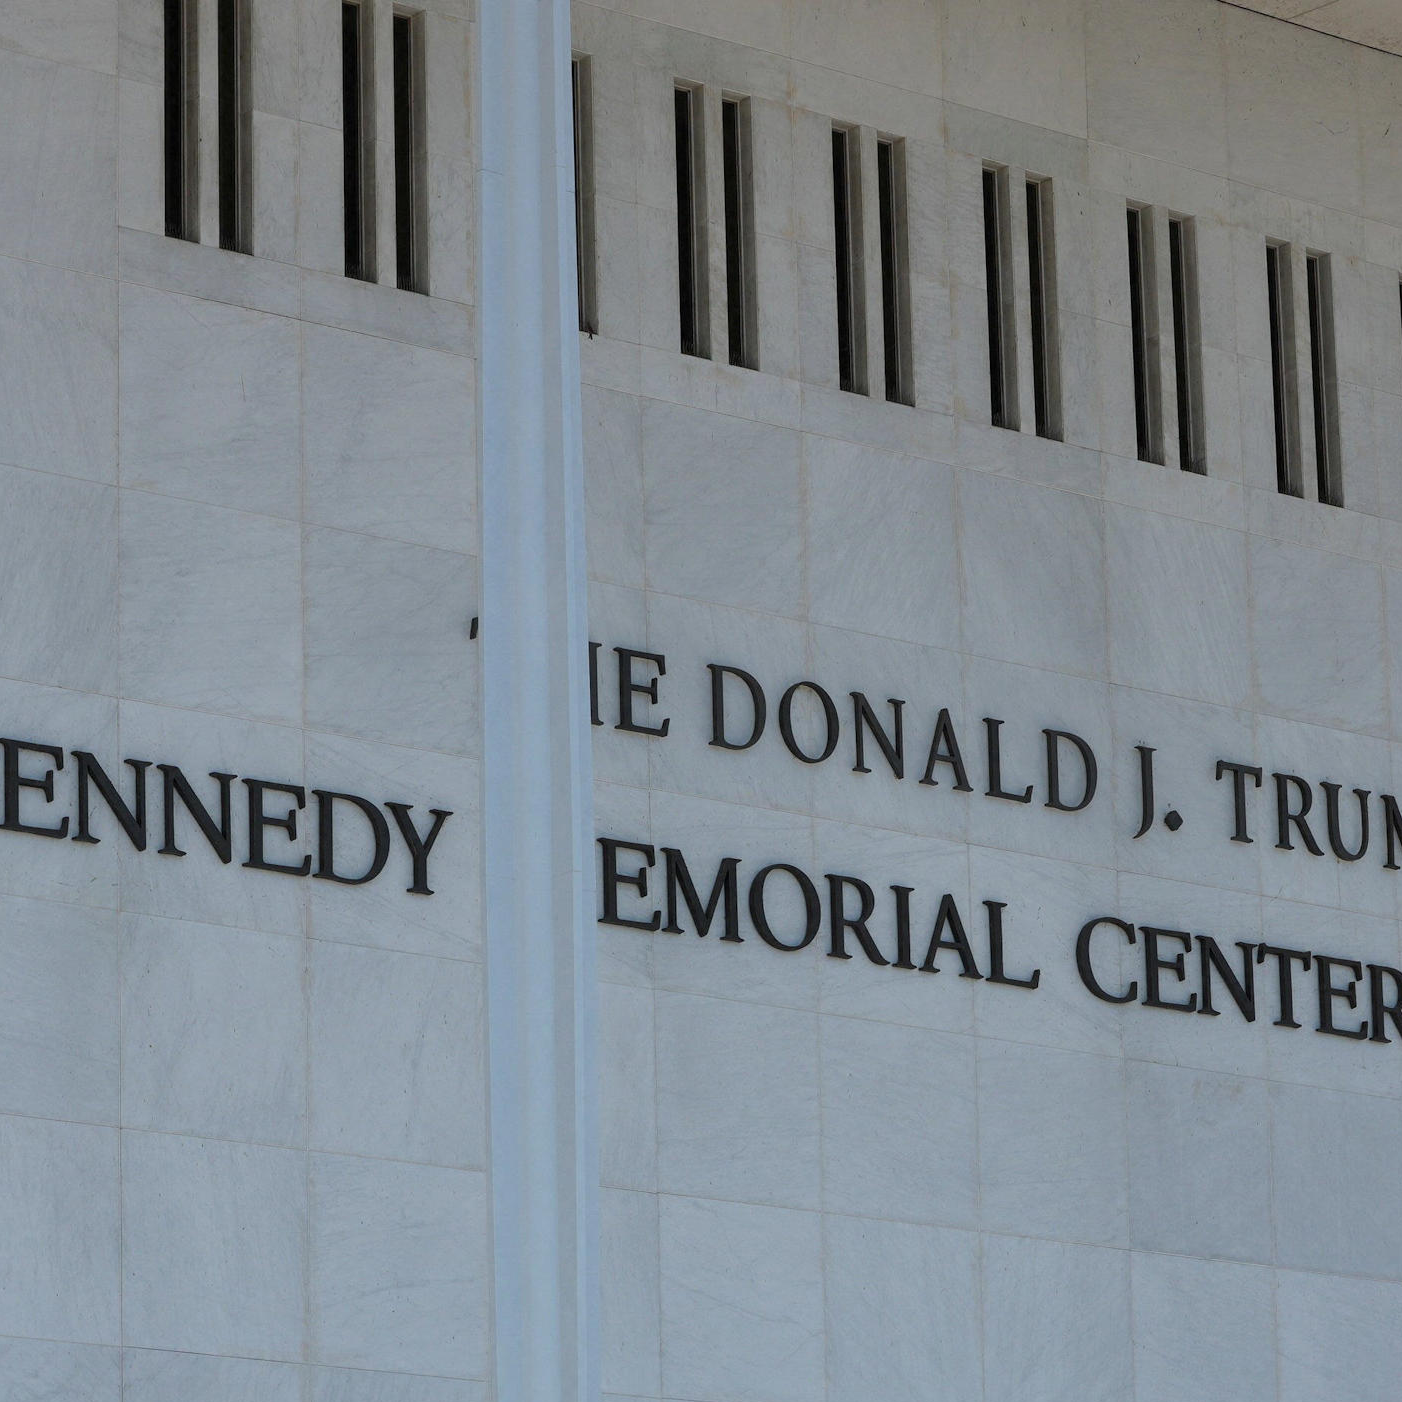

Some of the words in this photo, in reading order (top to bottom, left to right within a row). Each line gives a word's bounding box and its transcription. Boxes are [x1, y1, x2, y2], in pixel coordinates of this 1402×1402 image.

[705, 663, 1098, 812] DONALD
[1132, 744, 1185, 840] J.
[595, 836, 1041, 991] EMORIAL
